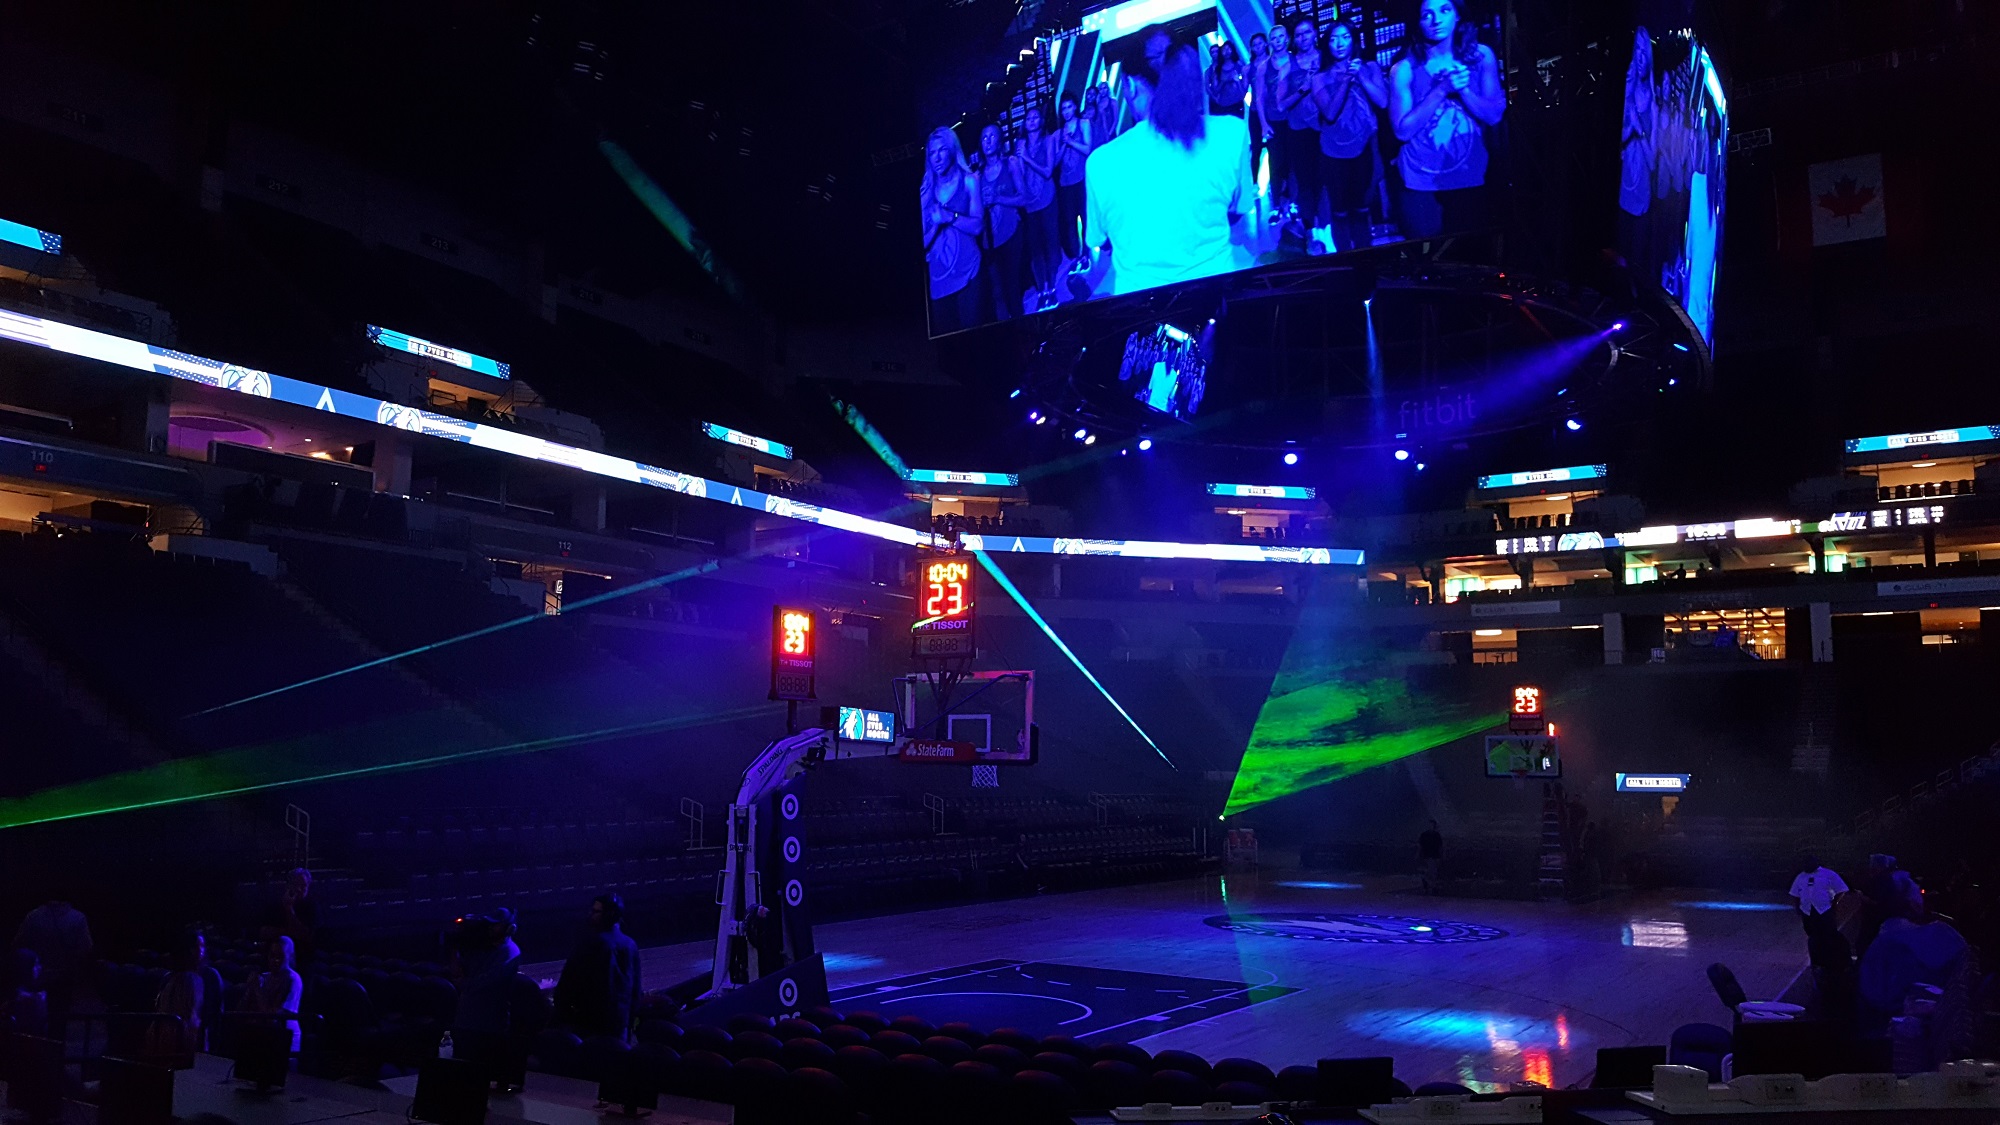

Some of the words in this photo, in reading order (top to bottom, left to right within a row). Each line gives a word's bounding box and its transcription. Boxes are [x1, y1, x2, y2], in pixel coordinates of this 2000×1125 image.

[62, 107, 87, 125] 211
[268, 179, 289, 194] 212
[431, 237, 449, 251] 213
[1399, 392, 1476, 429] fitbit
[30, 449, 54, 463] 110
[558, 541, 573, 551] 112
[928, 562, 968, 583] 10:04
[926, 582, 963, 616] 23
[932, 619, 968, 631] TISSOT
[789, 659, 813, 668] TISSOT
[1515, 696, 1536, 713] 23
[867, 712, 879, 722] ALL
[758, 746, 784, 776] SPALDING
